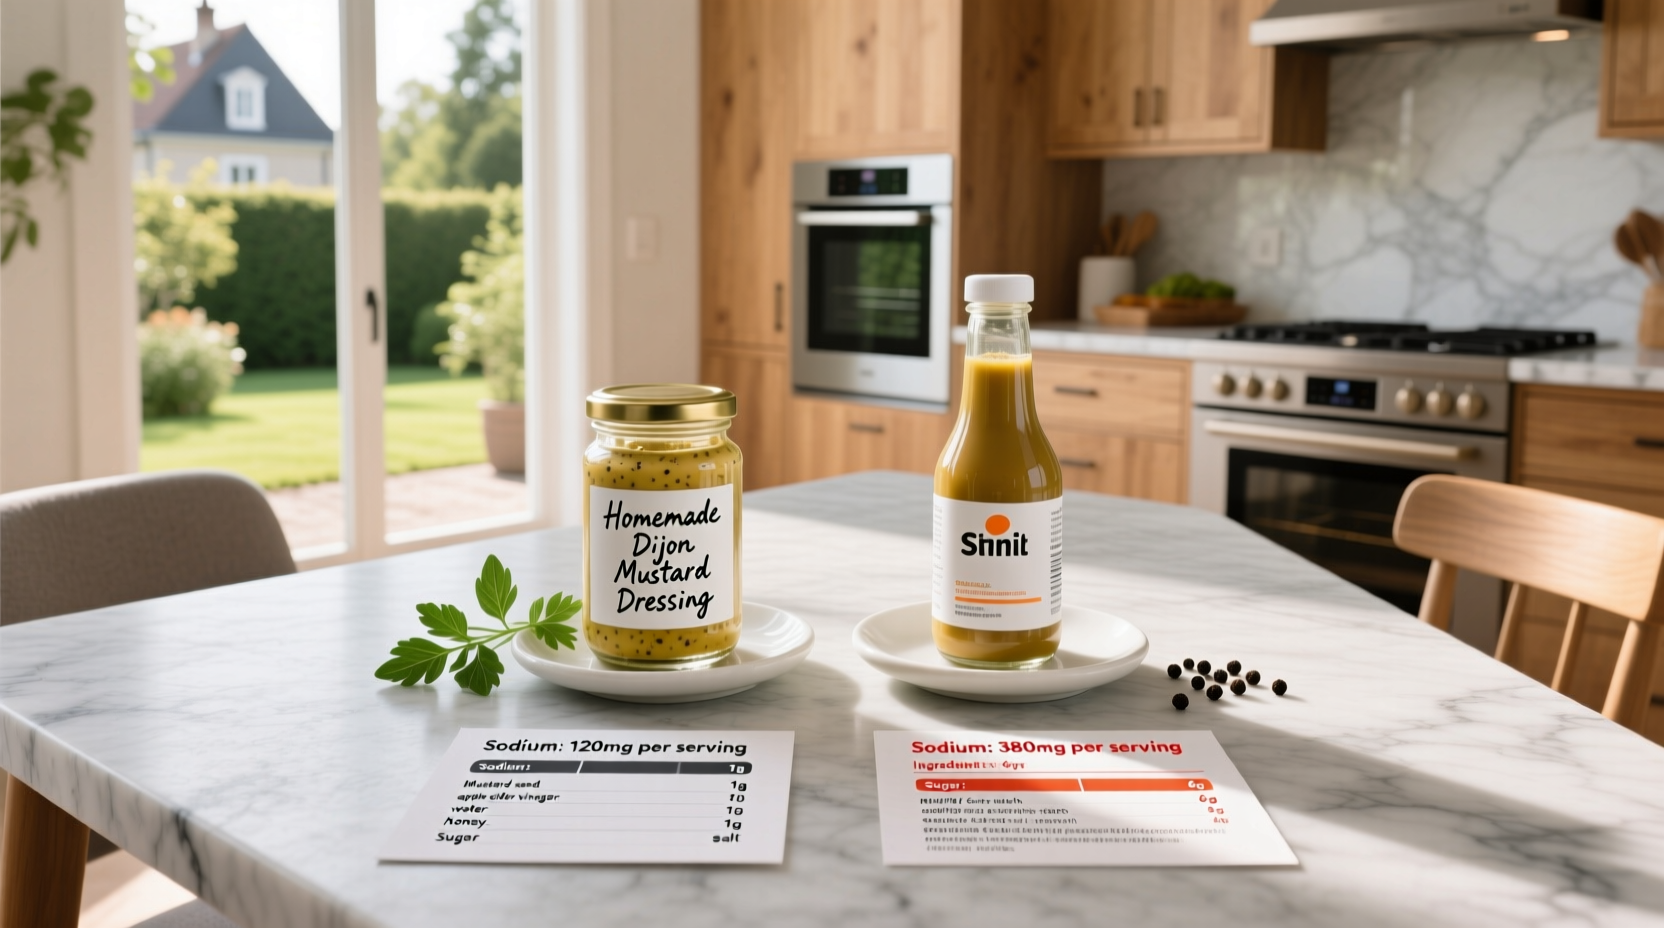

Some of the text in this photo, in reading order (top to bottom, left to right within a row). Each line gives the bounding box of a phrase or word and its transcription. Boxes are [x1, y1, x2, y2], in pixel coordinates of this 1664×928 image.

[603, 498, 721, 530] Homemade
[632, 532, 695, 565] Dijon
[613, 554, 711, 584] Mustard
[616, 587, 714, 619] Dressing
[570, 740, 633, 756] 120mg
[638, 743, 671, 755] per
[676, 741, 747, 757] serving
[912, 740, 1182, 755] Sodium: 380mg per serving
[435, 832, 480, 845] Sugar
